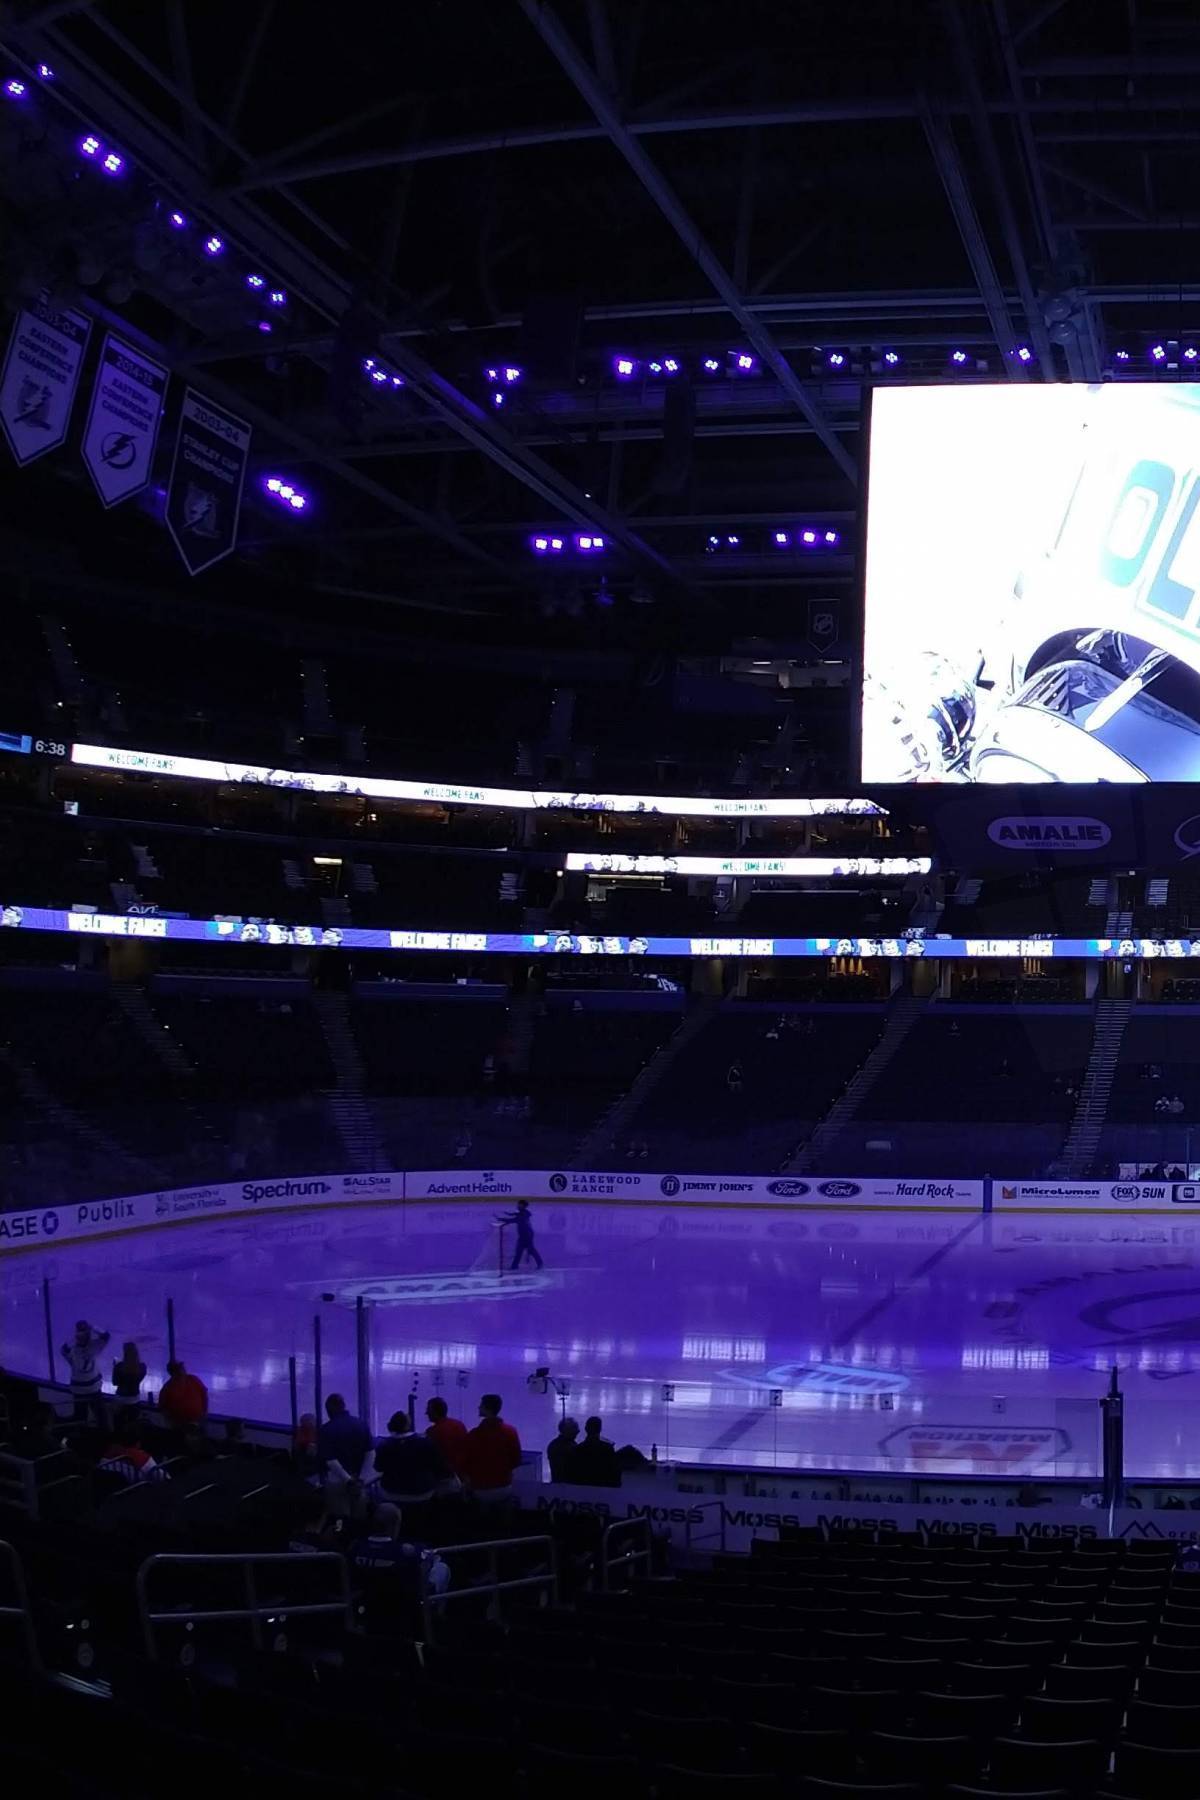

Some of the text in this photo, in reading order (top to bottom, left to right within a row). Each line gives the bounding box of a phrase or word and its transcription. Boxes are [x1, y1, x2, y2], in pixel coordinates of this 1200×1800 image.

[35, 740, 66, 757] 6:38
[108, 753, 149, 768] WELCOME
[423, 788, 462, 799] WELCOME
[1000, 825, 1103, 841] AMALIE
[571, 1174, 640, 1185] LAKEWOOD
[241, 1180, 326, 1204] Spectrum
[427, 1182, 512, 1194] AdventHealth
[571, 1184, 614, 1194] RANCH
[682, 1182, 753, 1193] JIMMY JOHN'S
[774, 1182, 803, 1195] Ford
[824, 1182, 854, 1196] Ford
[896, 1183, 954, 1199] Hard Rock
[1021, 1187, 1101, 1196] MicroLumen
[1116, 1187, 1166, 1199] FOX SUN
[77, 1199, 135, 1224] Publix
